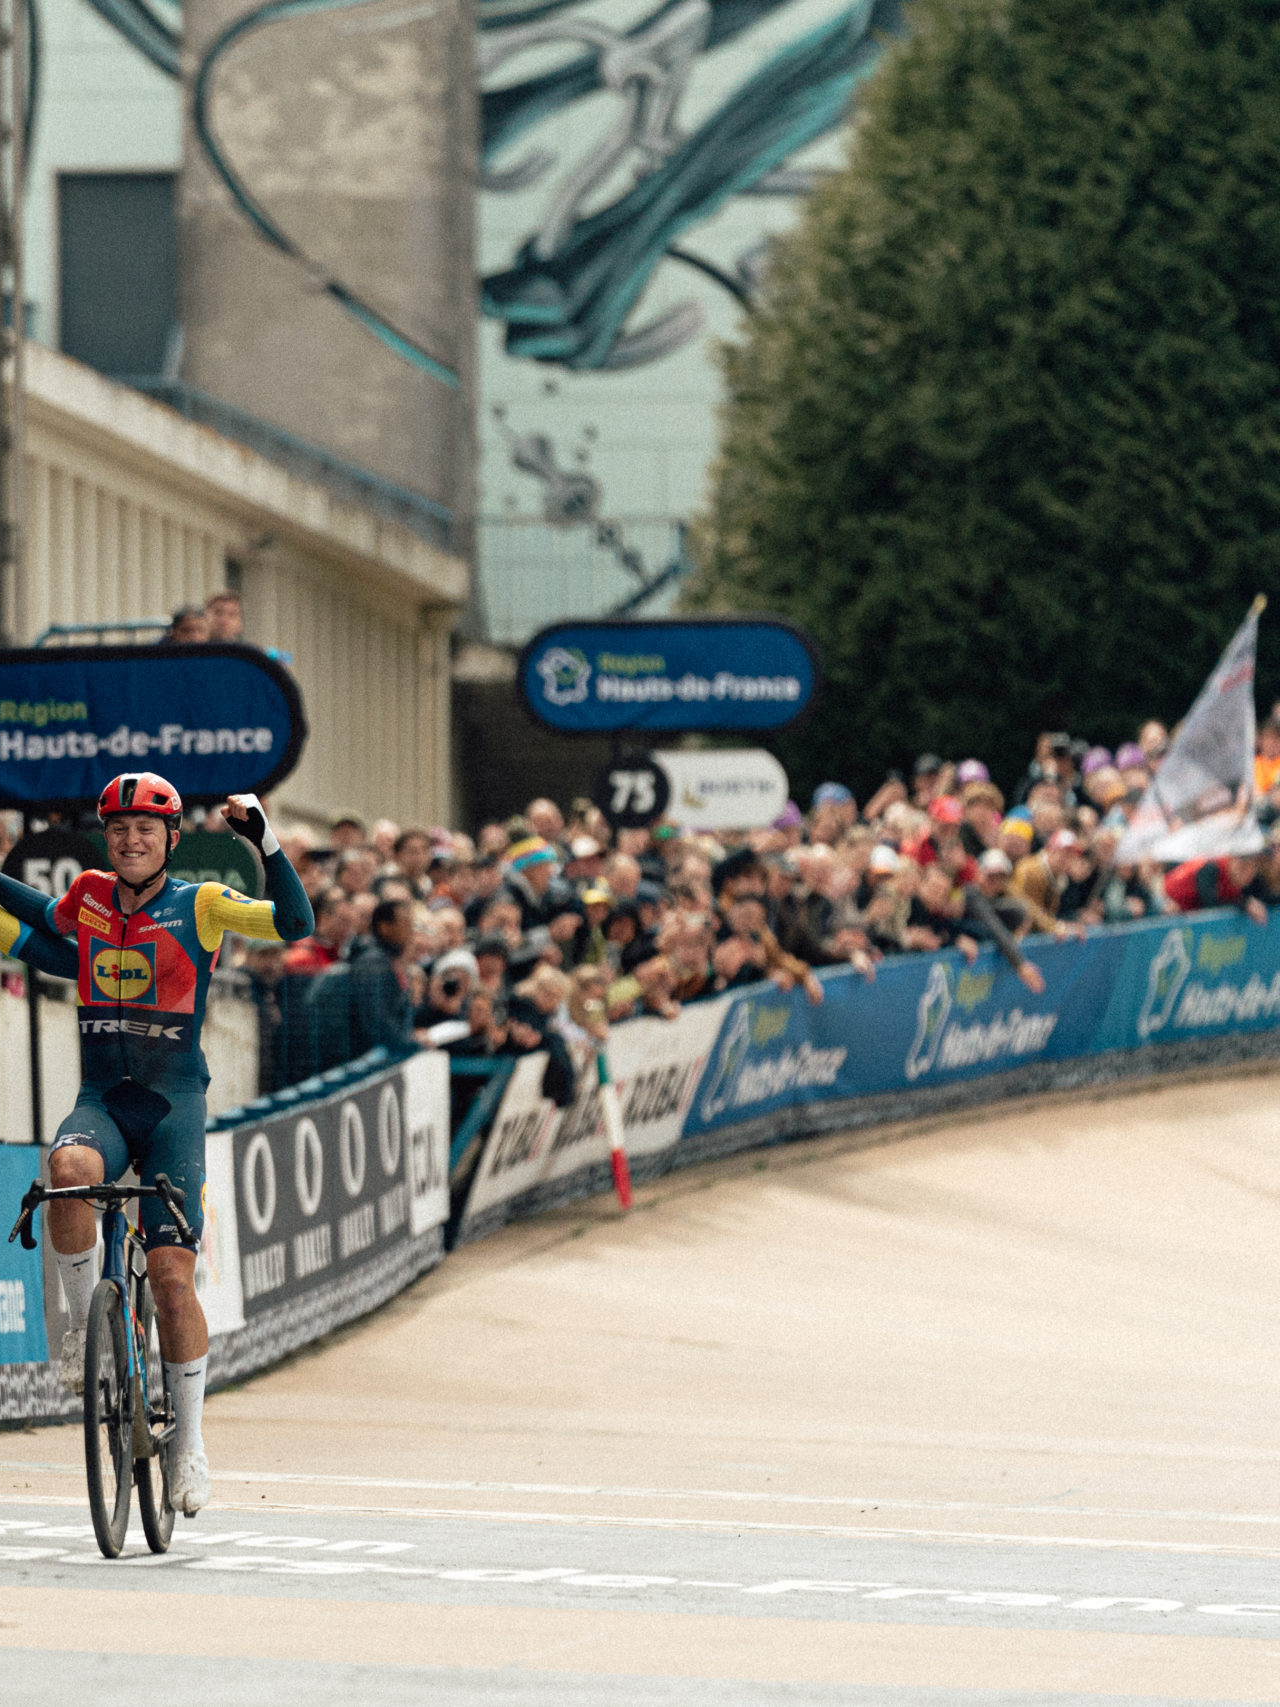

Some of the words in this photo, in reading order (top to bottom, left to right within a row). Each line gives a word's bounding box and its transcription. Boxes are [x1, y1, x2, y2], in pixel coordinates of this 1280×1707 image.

[609, 770, 656, 814] 75
[22, 857, 83, 898] 50
[82, 892, 113, 918] Santini
[79, 1019, 184, 1041] TREK
